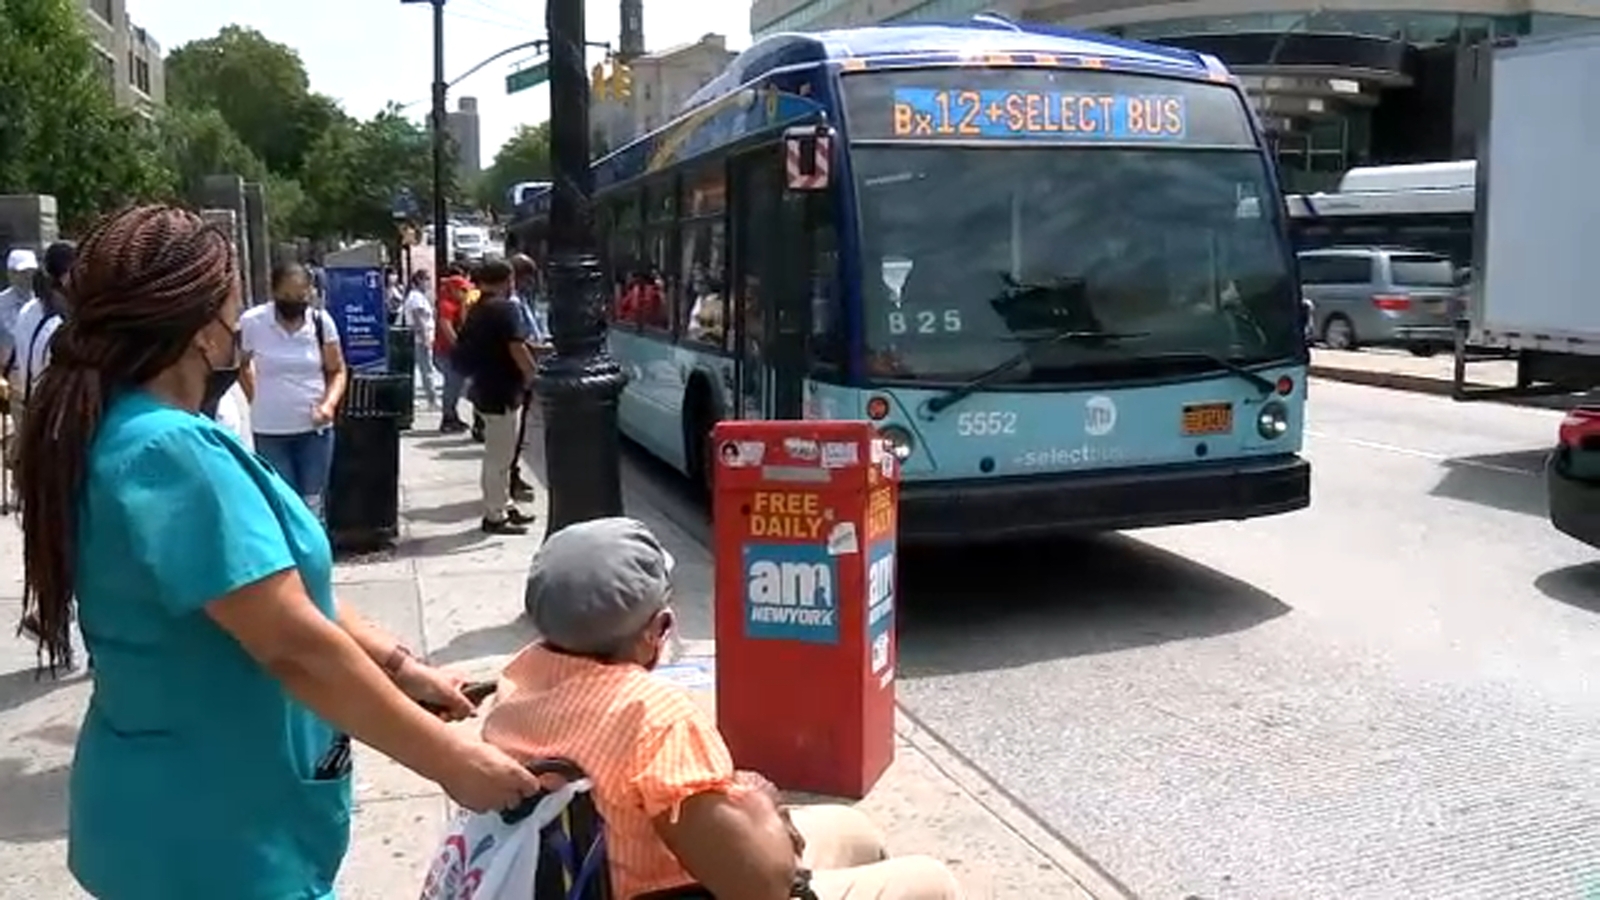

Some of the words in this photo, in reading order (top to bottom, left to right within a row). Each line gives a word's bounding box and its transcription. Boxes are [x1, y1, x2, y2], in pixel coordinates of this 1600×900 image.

[1127, 97, 1182, 134] BUS
[957, 410, 1018, 437] 5552
[753, 491, 819, 516] FREE
[751, 515, 823, 539] DAILY
[749, 559, 833, 607] am
[750, 606, 836, 627] NEWYORK
